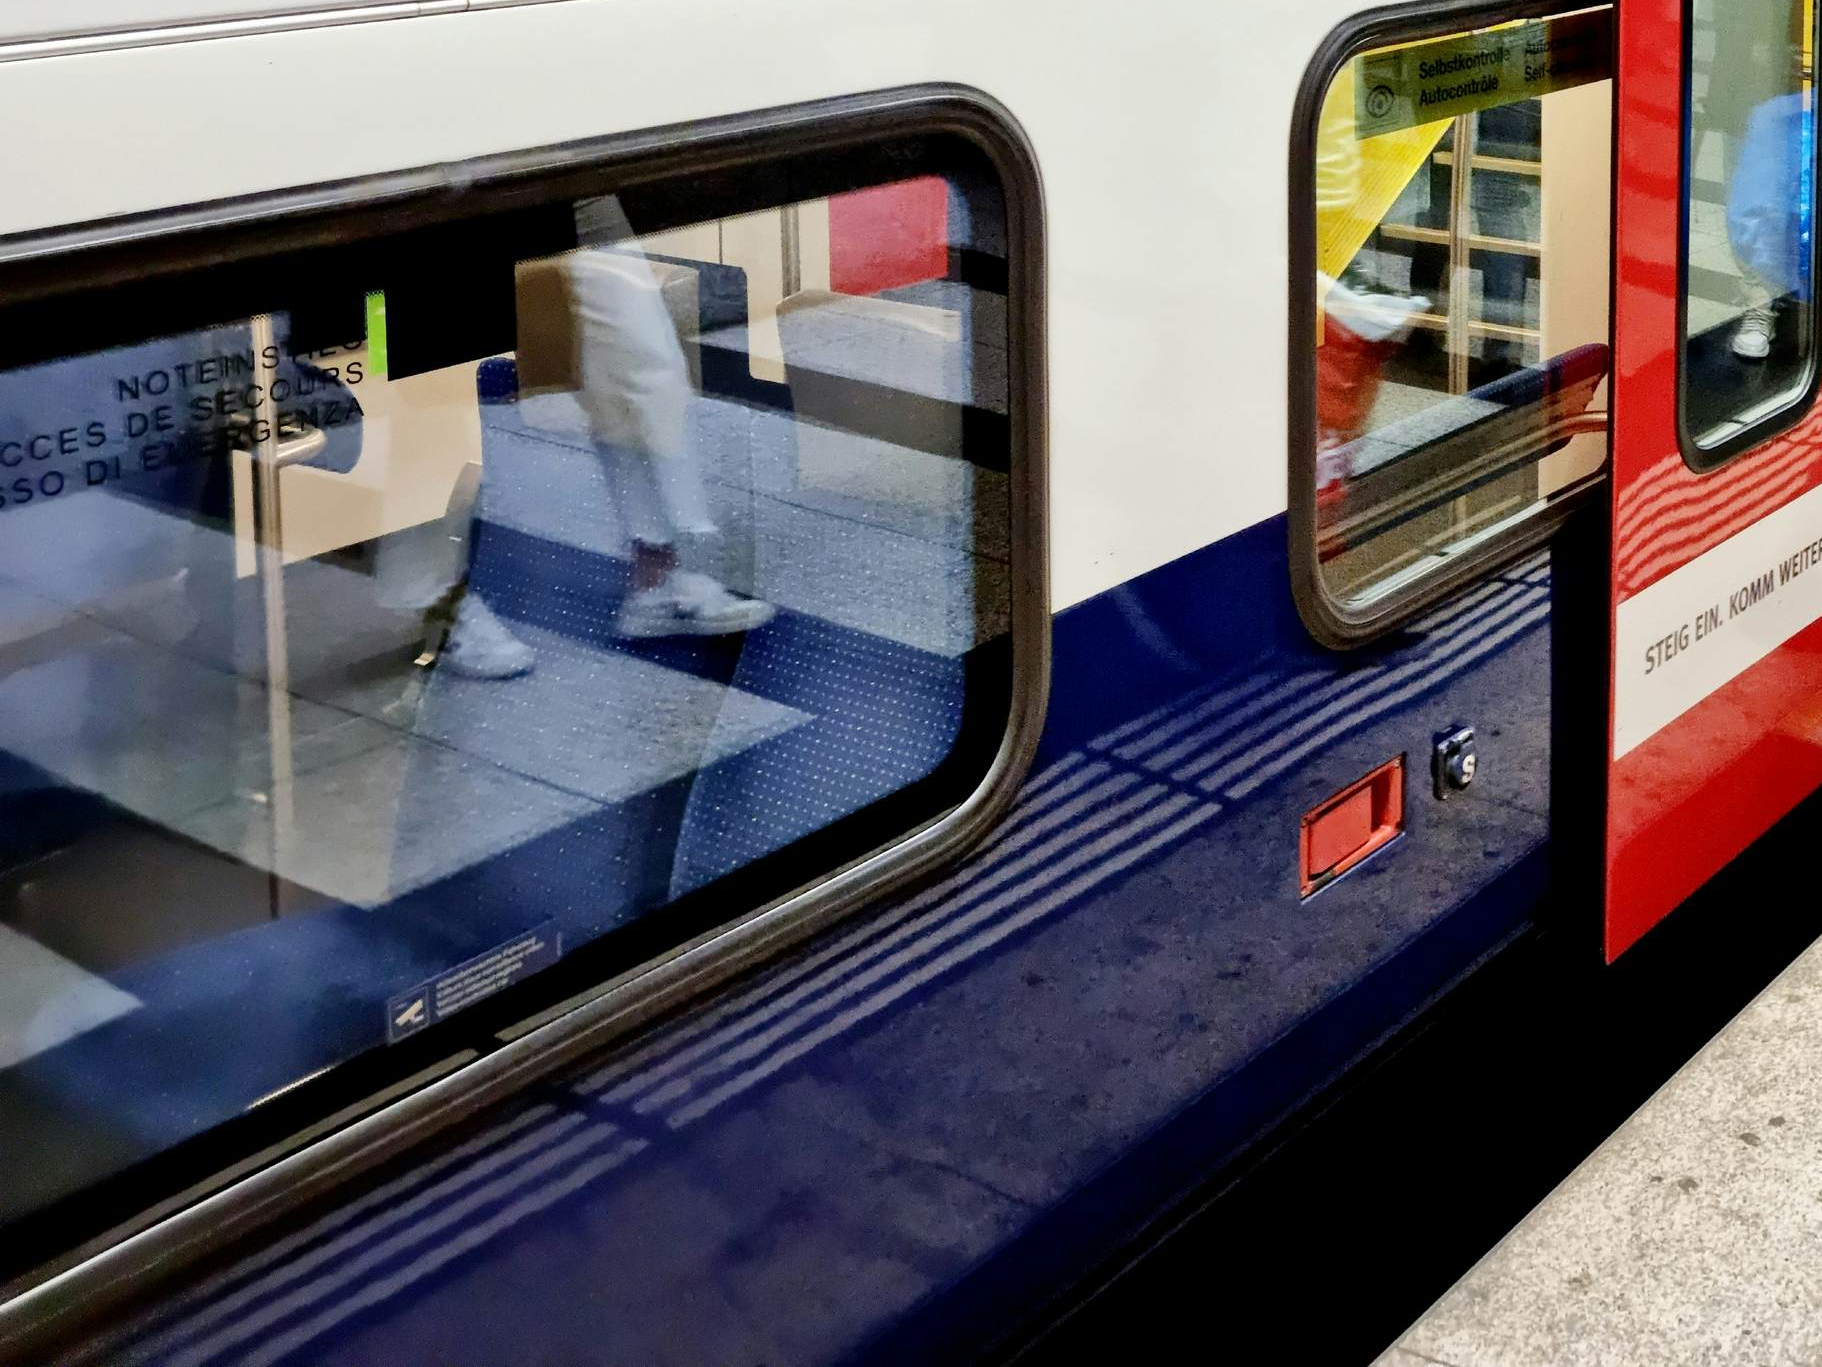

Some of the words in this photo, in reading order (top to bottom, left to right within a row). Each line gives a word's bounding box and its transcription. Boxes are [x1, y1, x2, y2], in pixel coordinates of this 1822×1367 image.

[1418, 47, 1511, 80] Selbstkontrolle
[1419, 78, 1499, 107] Autocontrôle
[127, 405, 175, 438] DE
[191, 361, 364, 422] SECOURS
[0, 470, 66, 509] SO
[86, 460, 121, 486] DI
[1644, 624, 1689, 674] STEIG
[1694, 605, 1723, 642] EIN.
[1729, 569, 1774, 620] KOMM
